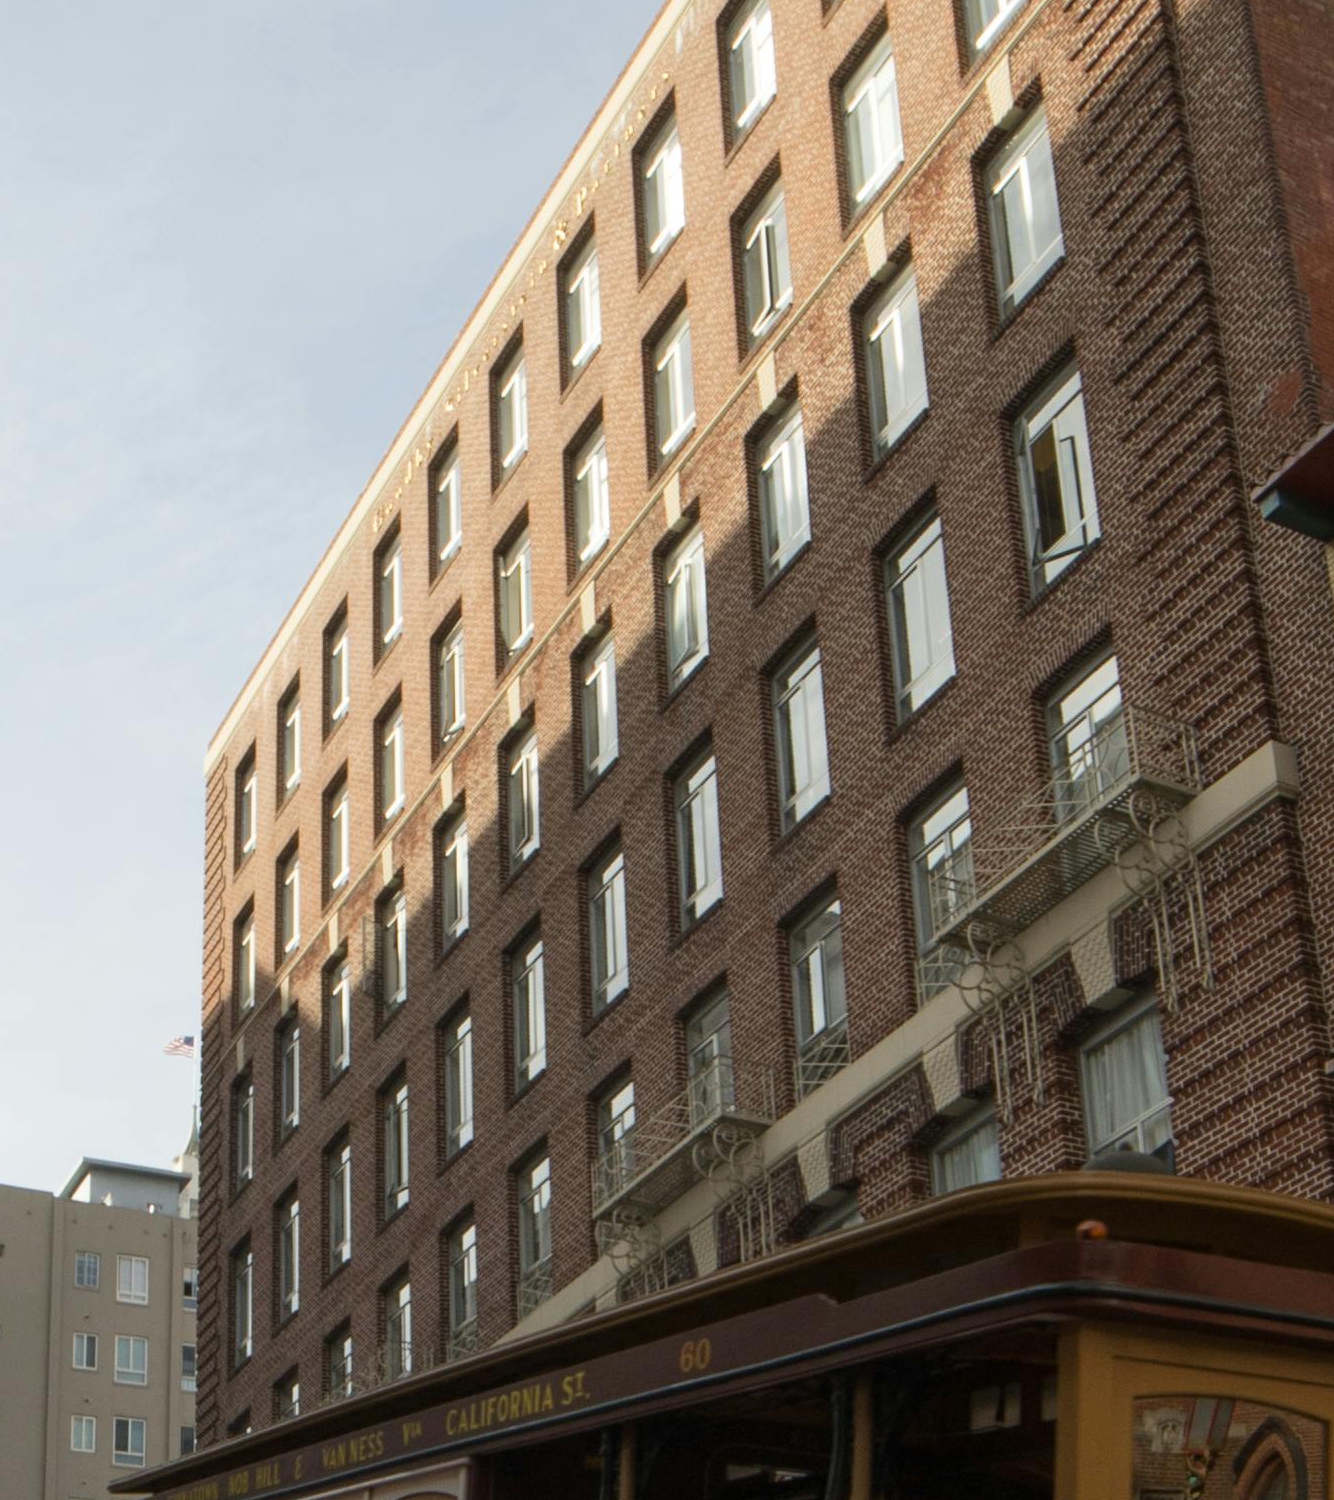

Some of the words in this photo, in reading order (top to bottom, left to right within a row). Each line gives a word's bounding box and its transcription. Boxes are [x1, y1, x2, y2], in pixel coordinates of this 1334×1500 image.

[679, 1338, 713, 1374] 60
[227, 1470, 249, 1497] NOB
[254, 1462, 281, 1491] HILL
[322, 1442, 347, 1470] VAN
[348, 1430, 385, 1463] NESS
[446, 1380, 555, 1436] CALIFORNIA
